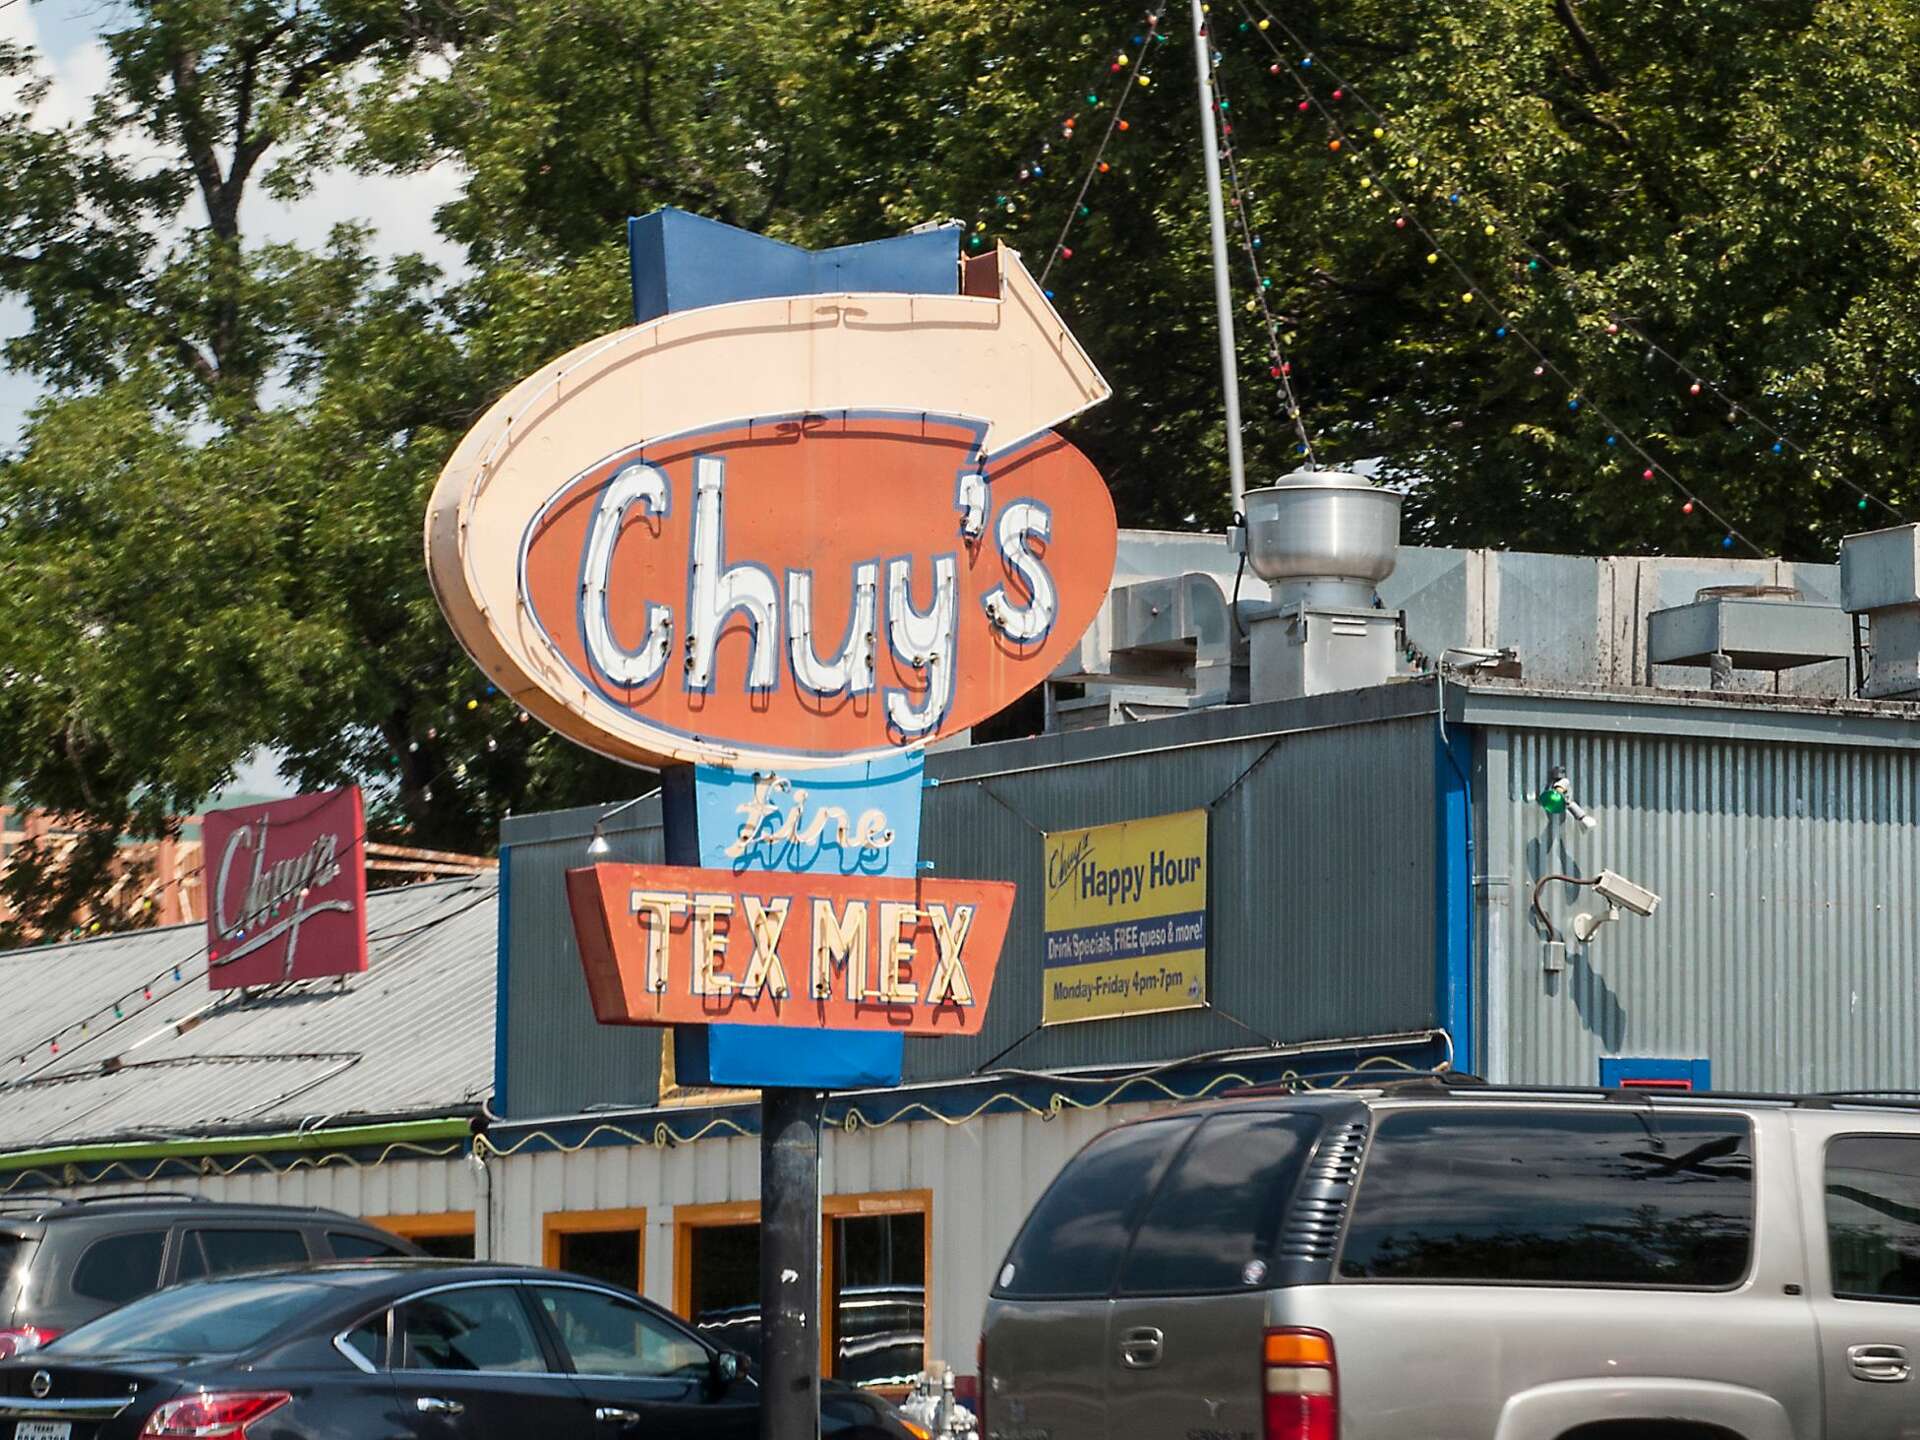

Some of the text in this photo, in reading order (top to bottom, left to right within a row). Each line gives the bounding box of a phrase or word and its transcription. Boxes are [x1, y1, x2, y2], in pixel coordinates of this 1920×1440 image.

[582, 457, 1056, 732] Chuy's
[723, 775, 895, 858] fine
[1081, 850, 1201, 906] Happy Hour
[630, 889, 976, 1008] TEX MEX
[1048, 915, 1204, 963] Drink Specials, FREE queso & more!
[1053, 967, 1184, 1002] Monday-Friday 4pm-7pm
